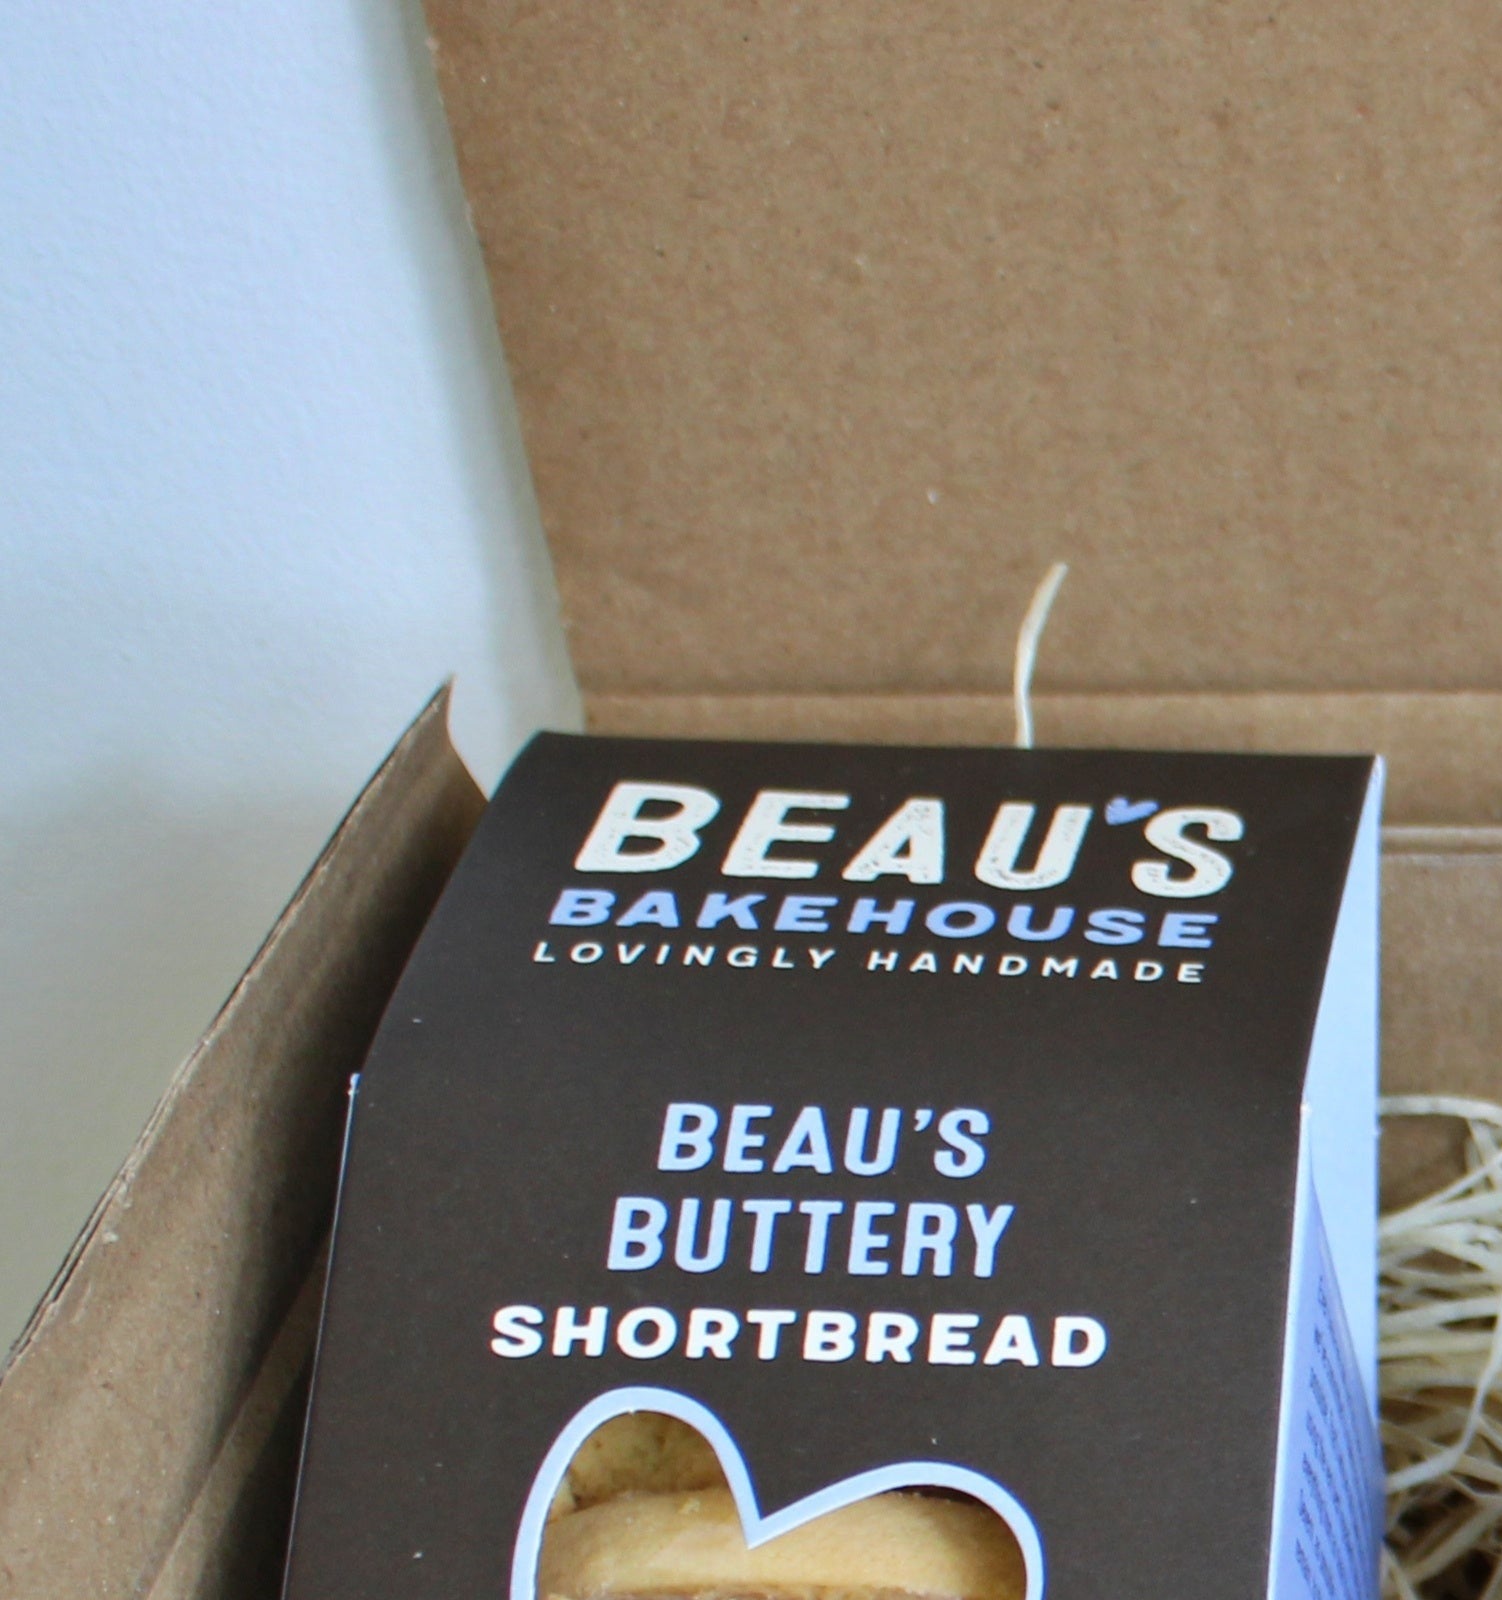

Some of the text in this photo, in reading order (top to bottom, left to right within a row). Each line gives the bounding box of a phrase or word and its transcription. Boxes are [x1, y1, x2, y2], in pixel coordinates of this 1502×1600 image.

[548, 888, 1219, 949] BAKEHOUSE
[532, 940, 1206, 984] LOVINGLY HANDMADE
[656, 1102, 990, 1178] BEAU'S
[606, 1196, 1015, 1278] BUTTERY
[490, 1304, 1107, 1368] SHORTBREAD
